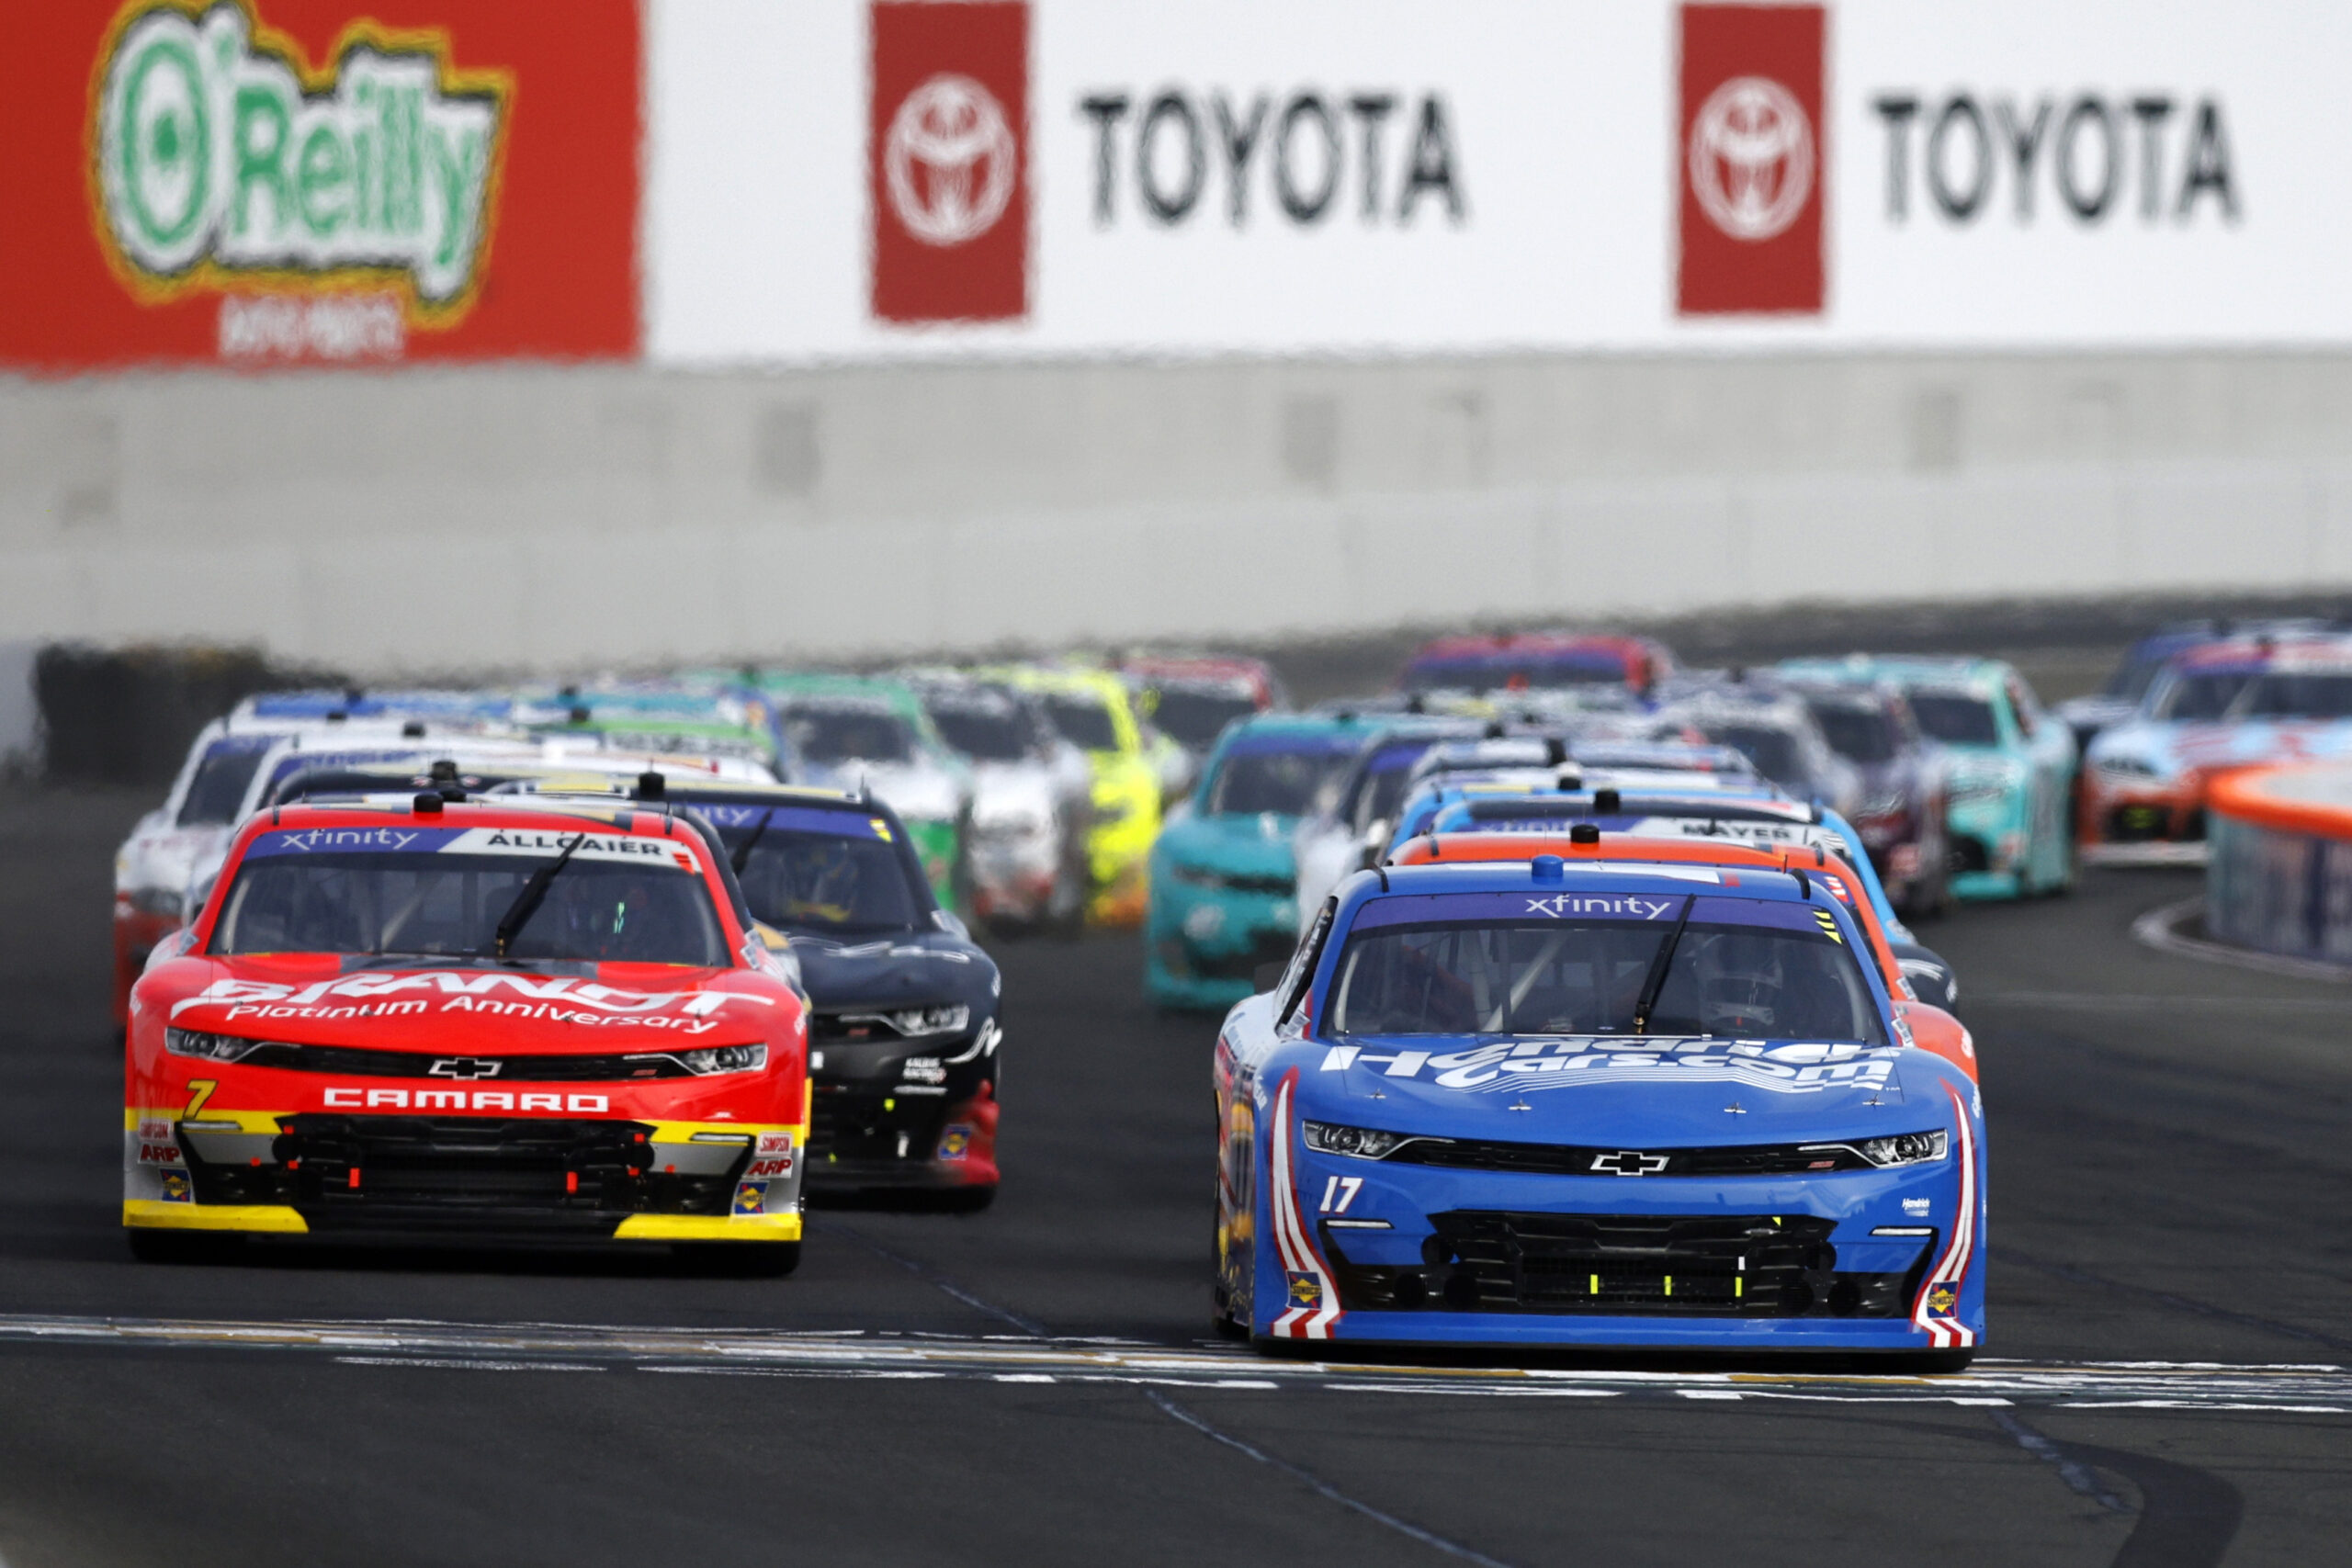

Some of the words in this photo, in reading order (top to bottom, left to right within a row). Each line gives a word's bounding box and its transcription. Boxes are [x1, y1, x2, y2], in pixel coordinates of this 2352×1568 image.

[112, 18, 488, 277] O'Reilly
[1079, 89, 1470, 228] TOYOTA
[1873, 94, 2243, 227] TOYOTA
[280, 828, 419, 851] xfinity
[1683, 823, 1792, 840] MAYER
[1525, 894, 1671, 920] xfinity
[171, 971, 775, 1017] BRANDT
[225, 999, 428, 1021] Platinum
[440, 995, 718, 1034] Anniversary
[183, 1078, 220, 1120] 7
[323, 1088, 609, 1112] CAMARO
[140, 1144, 180, 1162] ARP
[748, 1158, 792, 1176] ARP
[1319, 1176, 1363, 1213] 17
